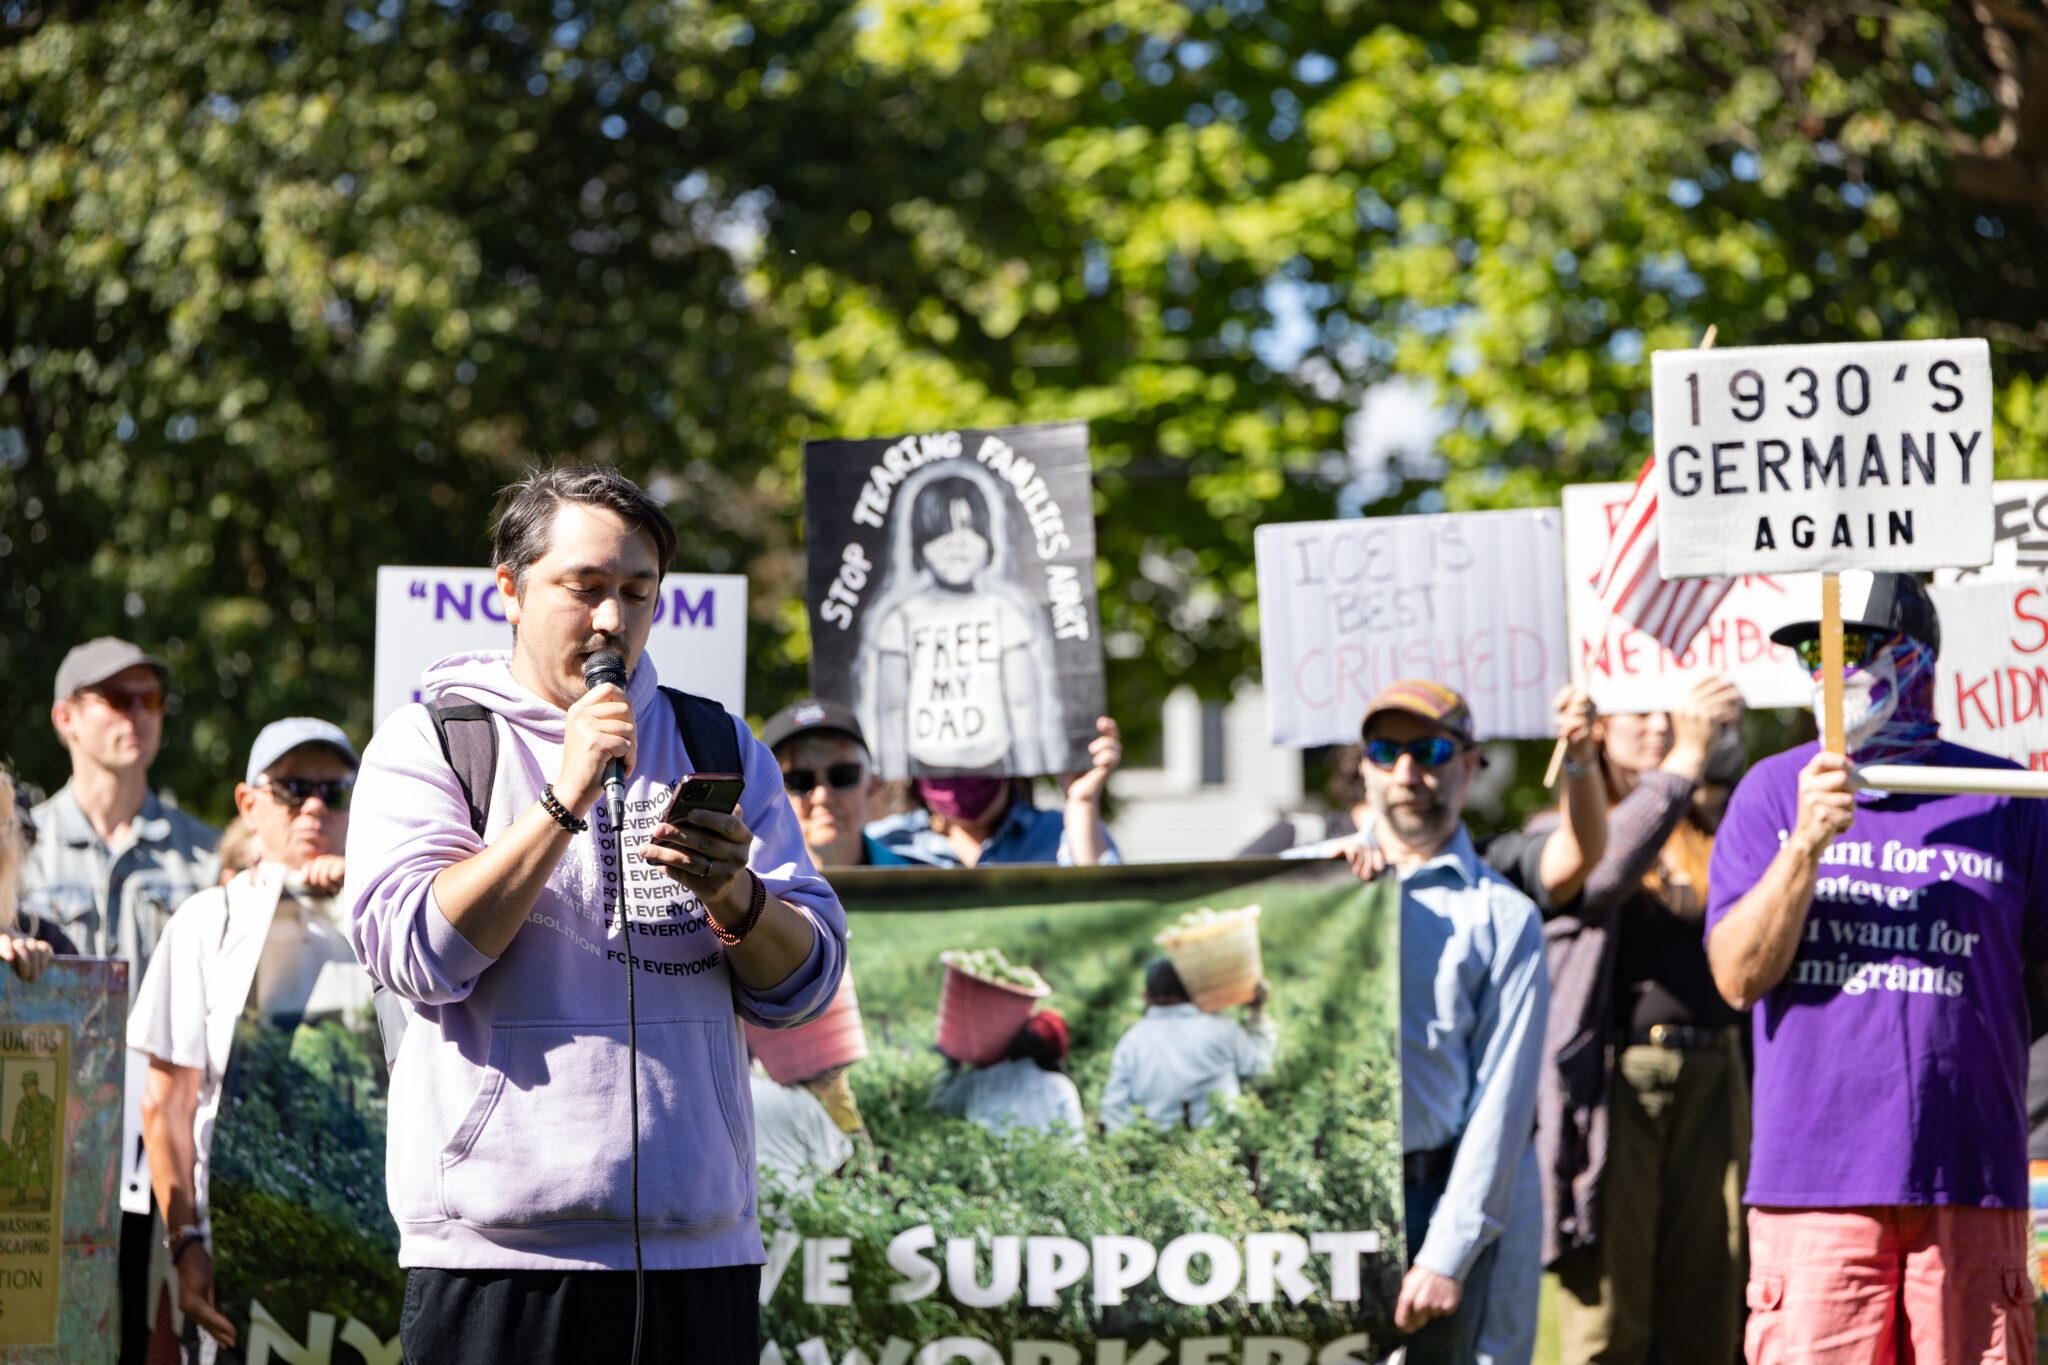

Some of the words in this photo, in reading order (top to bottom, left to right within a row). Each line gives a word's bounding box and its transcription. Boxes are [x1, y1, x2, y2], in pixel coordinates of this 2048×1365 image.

[1685, 359, 1965, 427] 1930'S
[1667, 431, 1982, 497] GERMANY
[820, 543, 872, 631] STOP
[852, 431, 962, 528] TEARING
[977, 435, 1070, 559] FAMILIES
[1045, 564, 1089, 641] APART
[1292, 527, 1394, 586] ICE
[1429, 520, 1475, 573] IS
[1754, 510, 1914, 550] AGAIN
[1327, 581, 1437, 635] BEST
[913, 620, 1000, 670] FREE
[1295, 624, 1550, 711] CRUSHED
[931, 676, 969, 702] MY
[915, 707, 985, 741] DAD
[1879, 839, 1938, 874] for
[1939, 849, 2003, 883] you
[604, 902, 633, 916] FOR
[636, 897, 704, 918] EVERYON
[604, 918, 636, 933] FOR
[638, 915, 710, 937] EVERYON
[1827, 920, 1921, 951] want
[1928, 919, 1980, 957] for
[607, 949, 641, 970] FOR
[643, 951, 720, 977] EVERYONE
[886, 1224, 1380, 1308] SUPPORT
